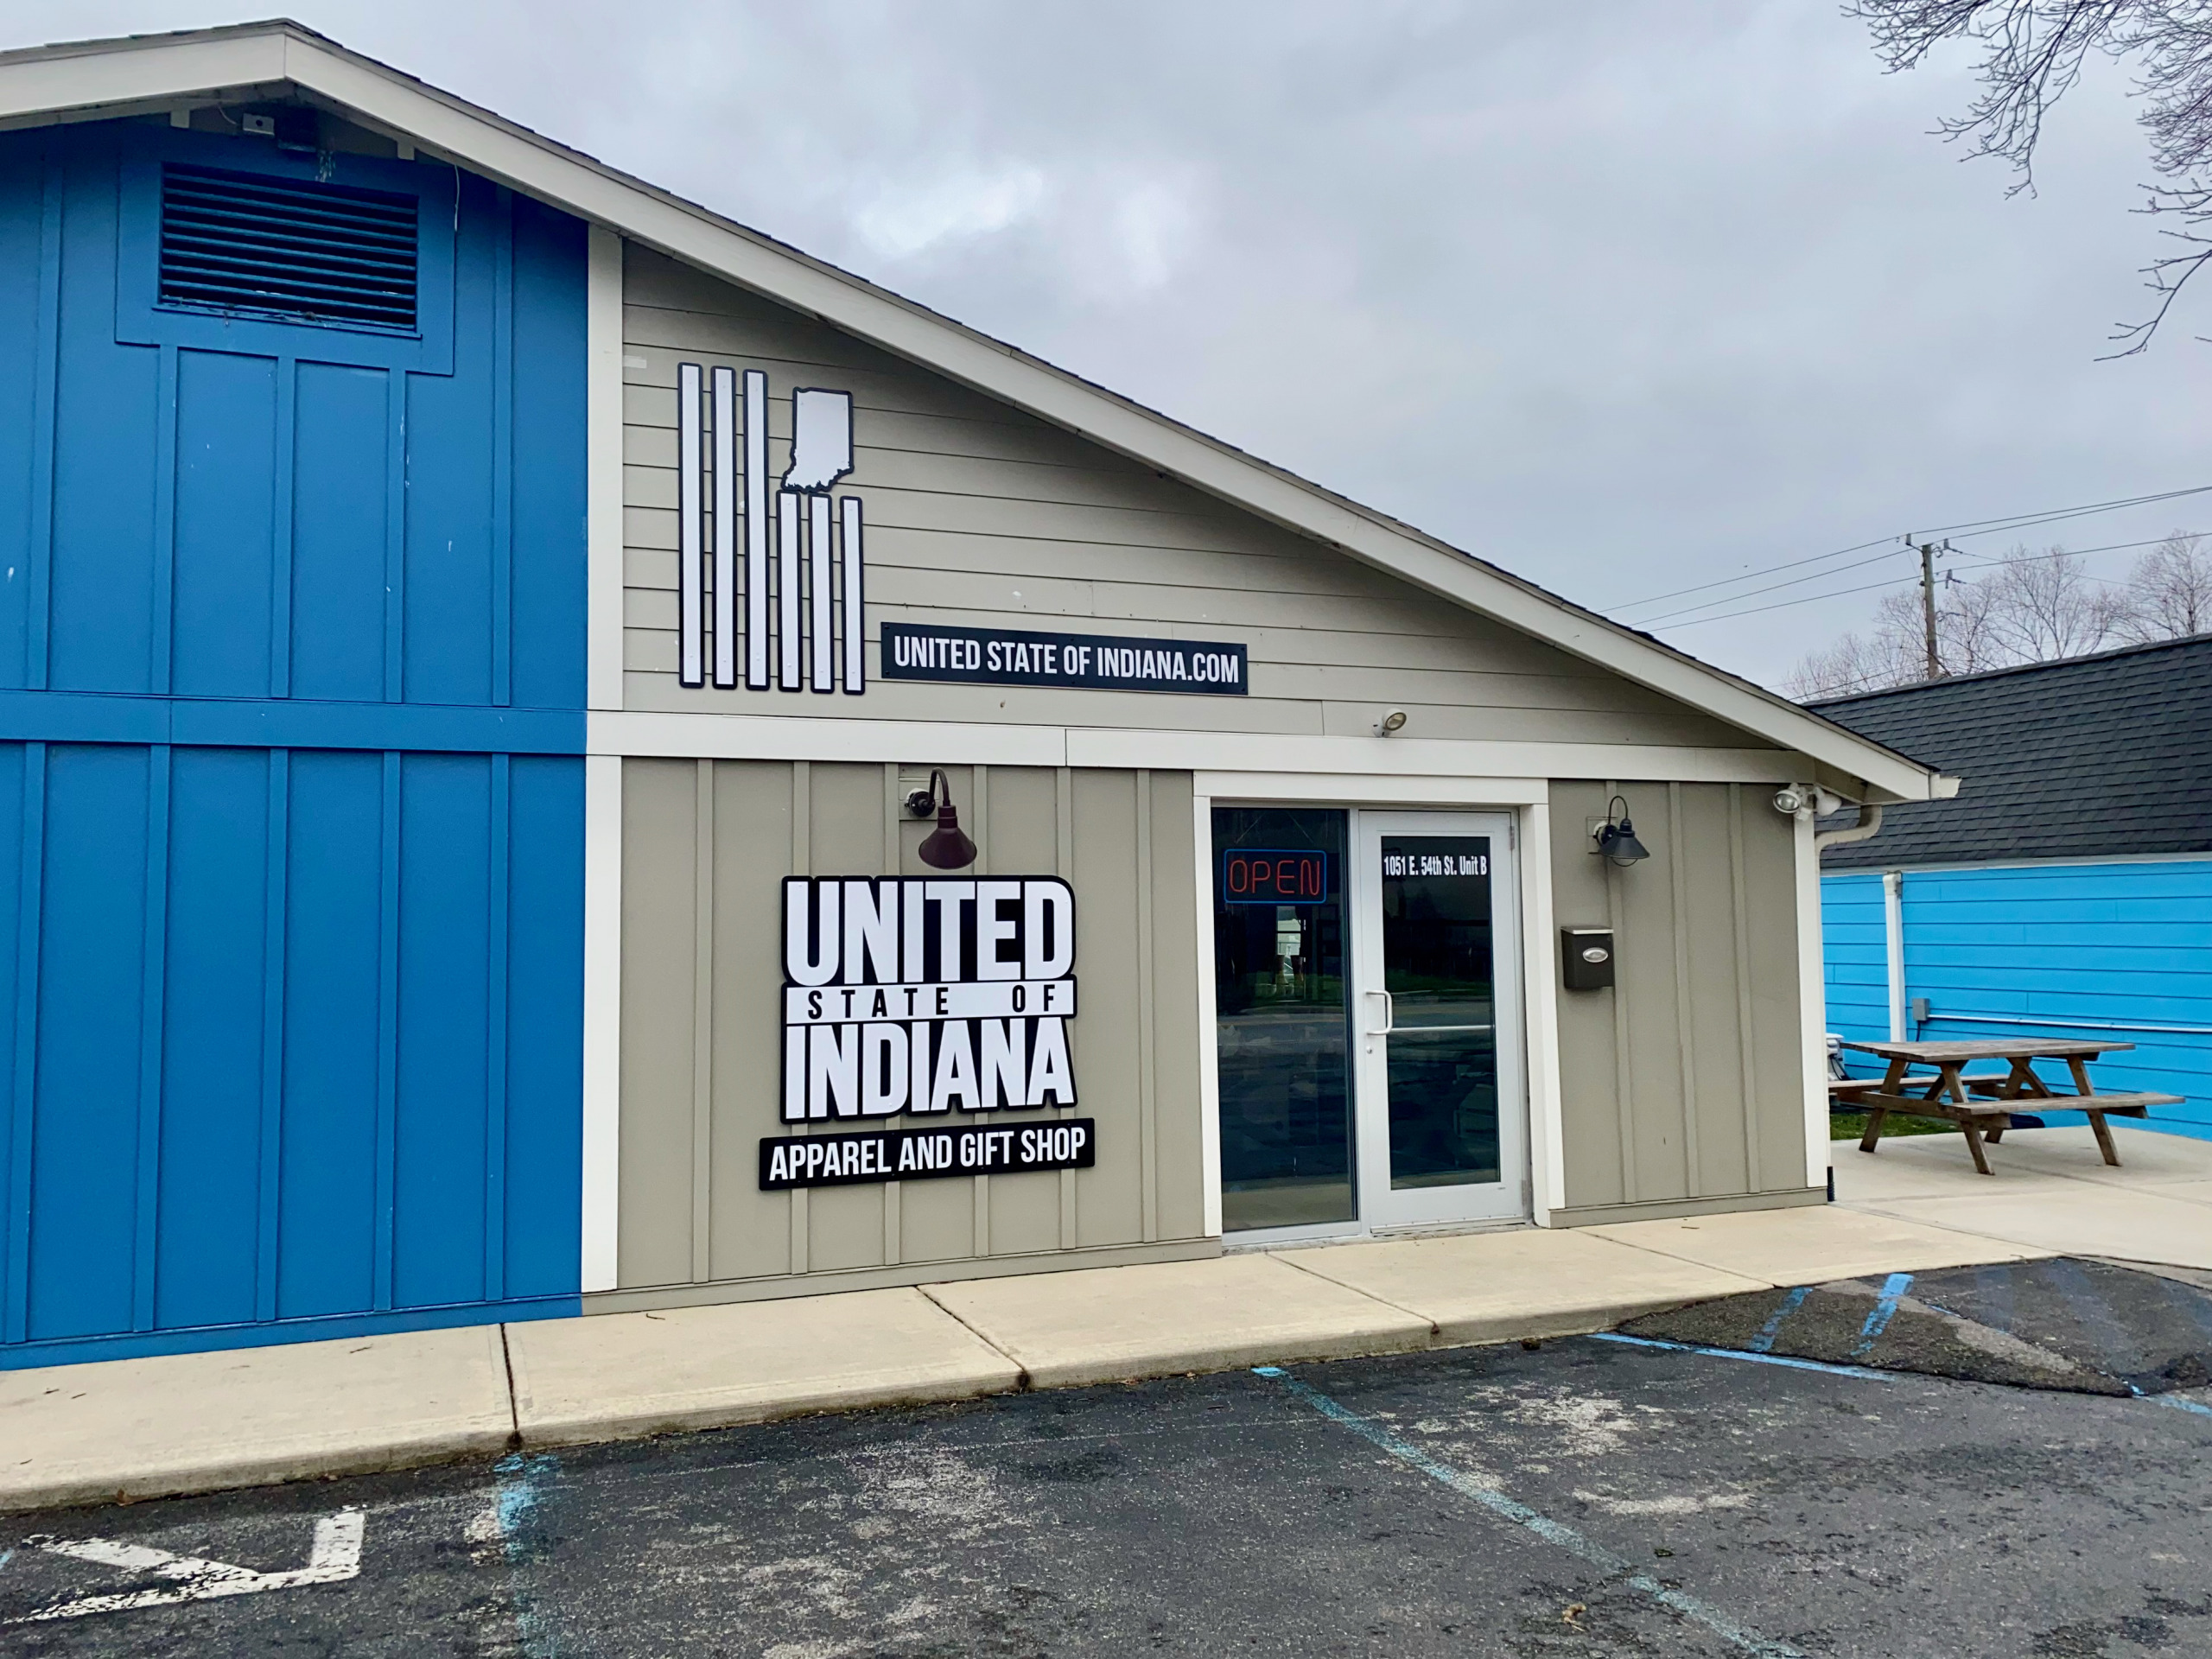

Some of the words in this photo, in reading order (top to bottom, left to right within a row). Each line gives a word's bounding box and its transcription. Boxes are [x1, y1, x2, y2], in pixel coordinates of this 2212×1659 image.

[894, 635, 981, 671] UNITED
[987, 640, 1058, 675] STATE
[1063, 645, 1091, 676] OF
[1097, 647, 1239, 683] INDIANA.COM
[1230, 859, 1320, 895] OPEN
[1384, 855, 1407, 875] 1051
[1408, 855, 1419, 875] E.
[1421, 855, 1442, 875] 54th
[1444, 855, 1458, 875] St.
[1459, 855, 1479, 875] Unit
[1480, 855, 1487, 875] B
[786, 880, 1072, 986] UNITED
[807, 987, 949, 1020] STATE
[1012, 984, 1056, 1013] OF
[785, 1016, 1074, 1119] INDIANA
[769, 1139, 892, 1181] APPAREL
[899, 1135, 952, 1172] AND
[960, 1131, 1014, 1167] GIFT
[1020, 1127, 1086, 1162] SHOP
